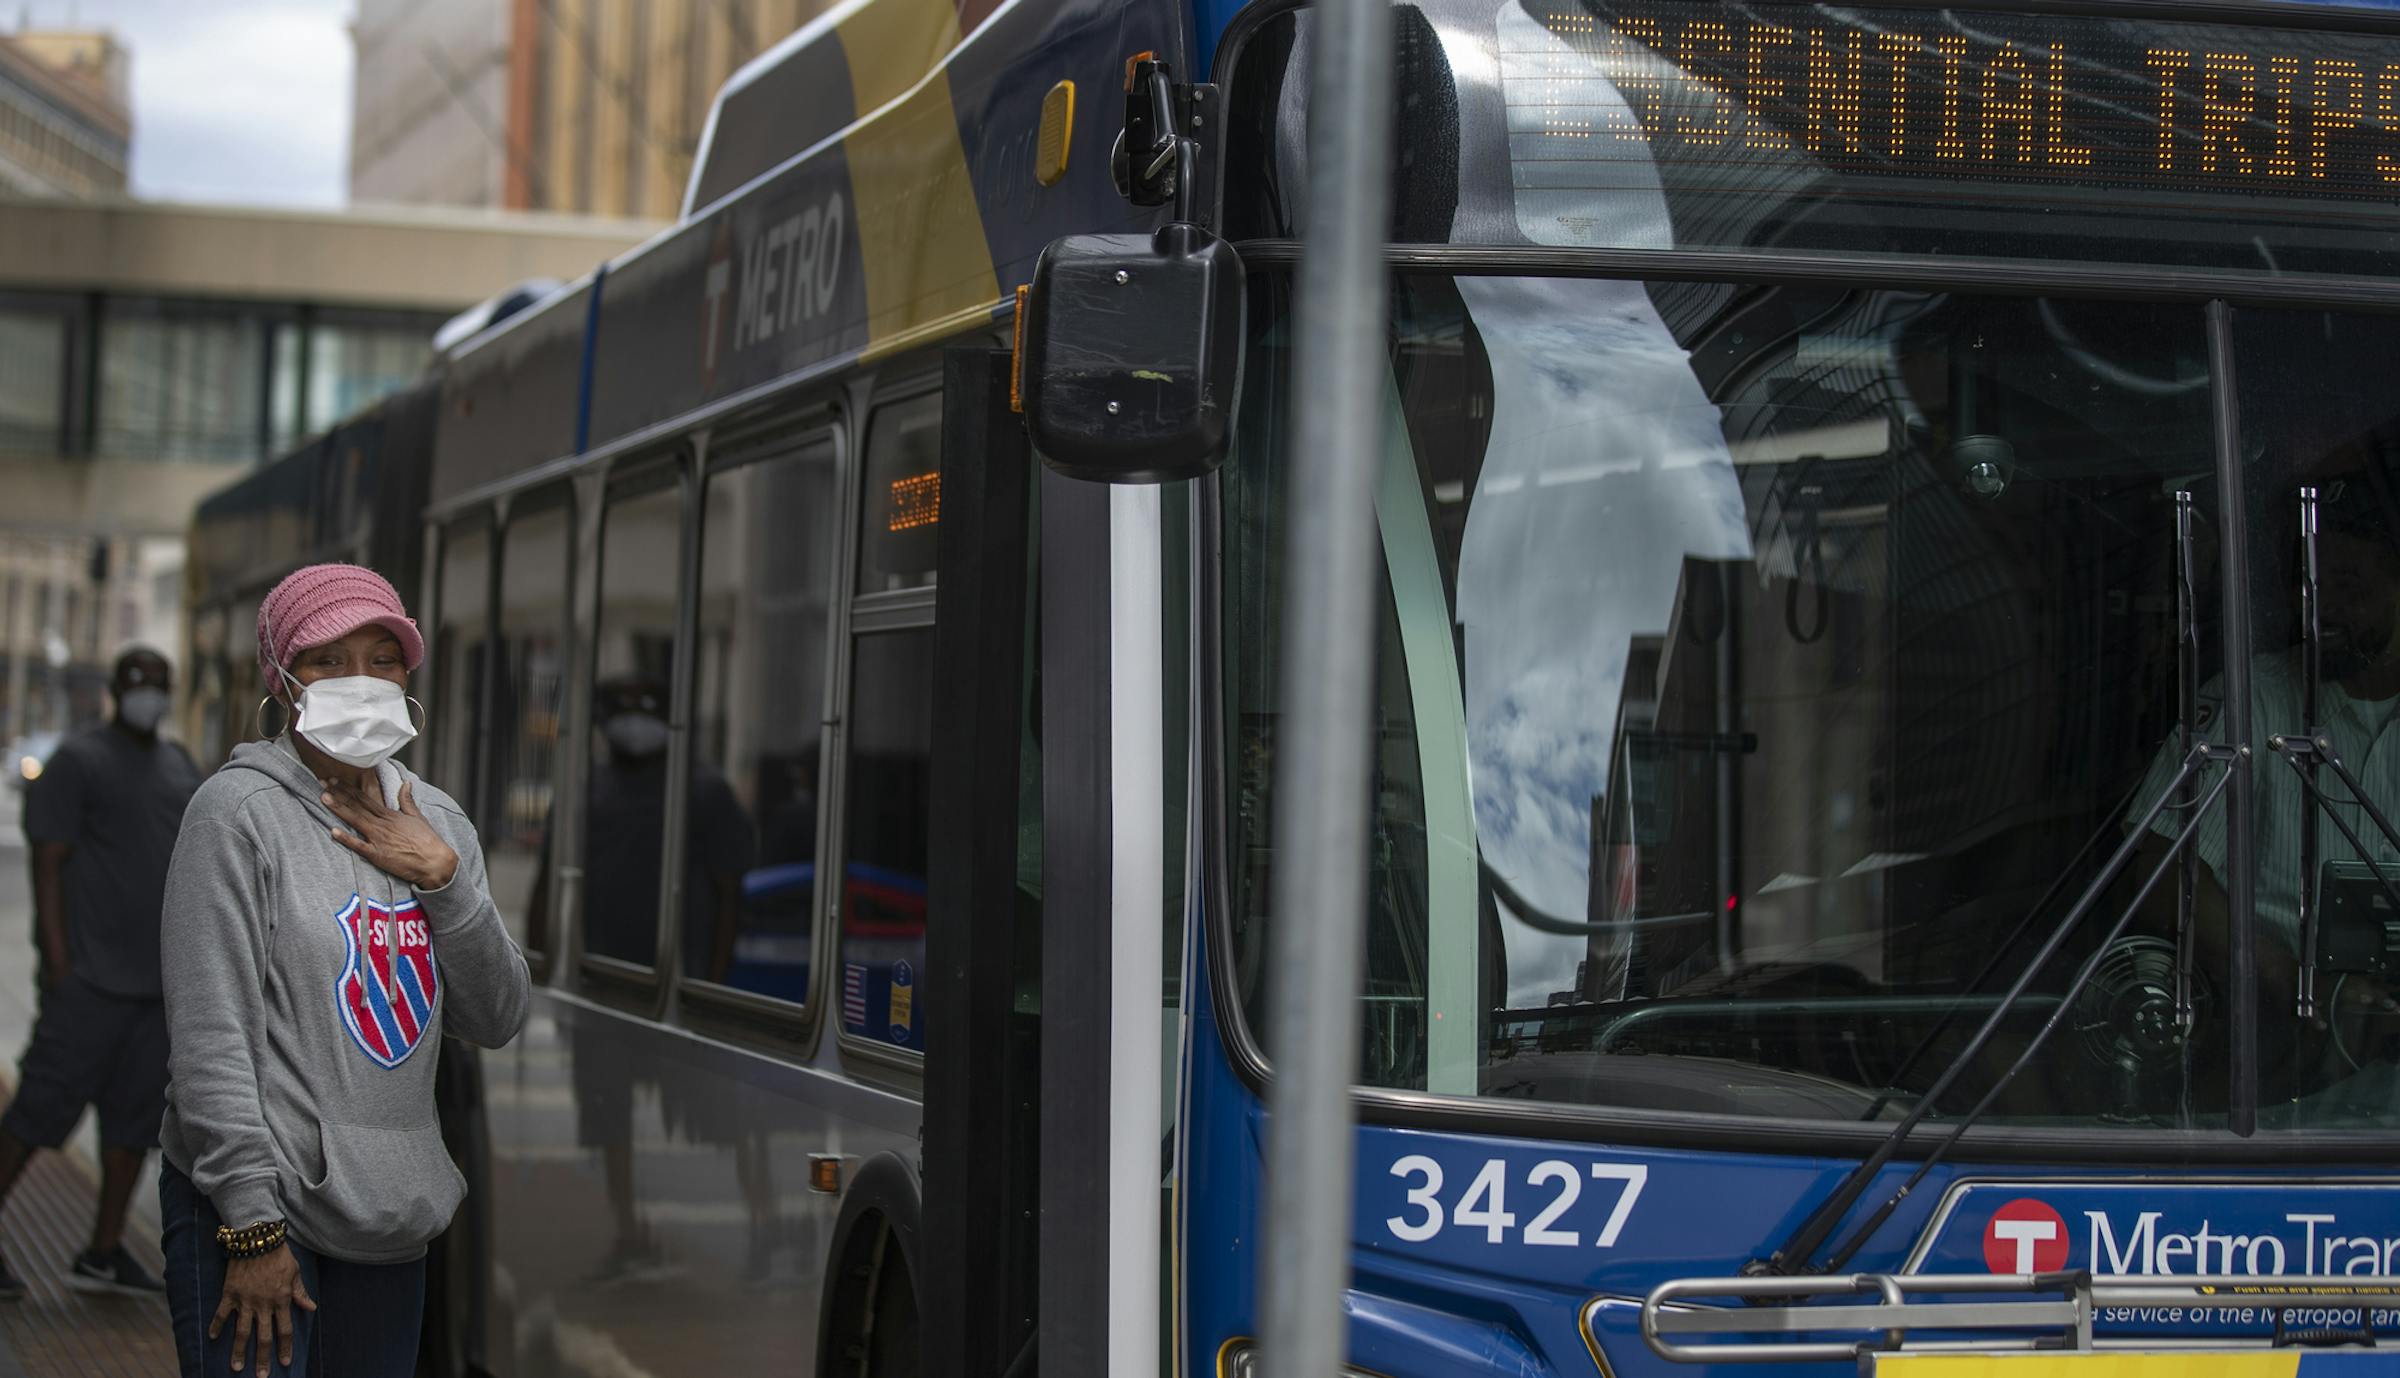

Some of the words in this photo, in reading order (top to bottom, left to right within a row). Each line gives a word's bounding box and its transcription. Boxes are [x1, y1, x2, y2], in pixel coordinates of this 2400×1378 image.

[1545, 14, 2092, 165] ESSENTIAL
[734, 191, 844, 352] METRO
[1386, 1154, 1648, 1248] 3427
[2083, 1210, 2286, 1276] Metro
[2104, 1307, 2182, 1323] service
[2189, 1307, 2212, 1323] of
[2218, 1307, 2254, 1323] the
[2261, 1307, 2400, 1330] Metropoltan
